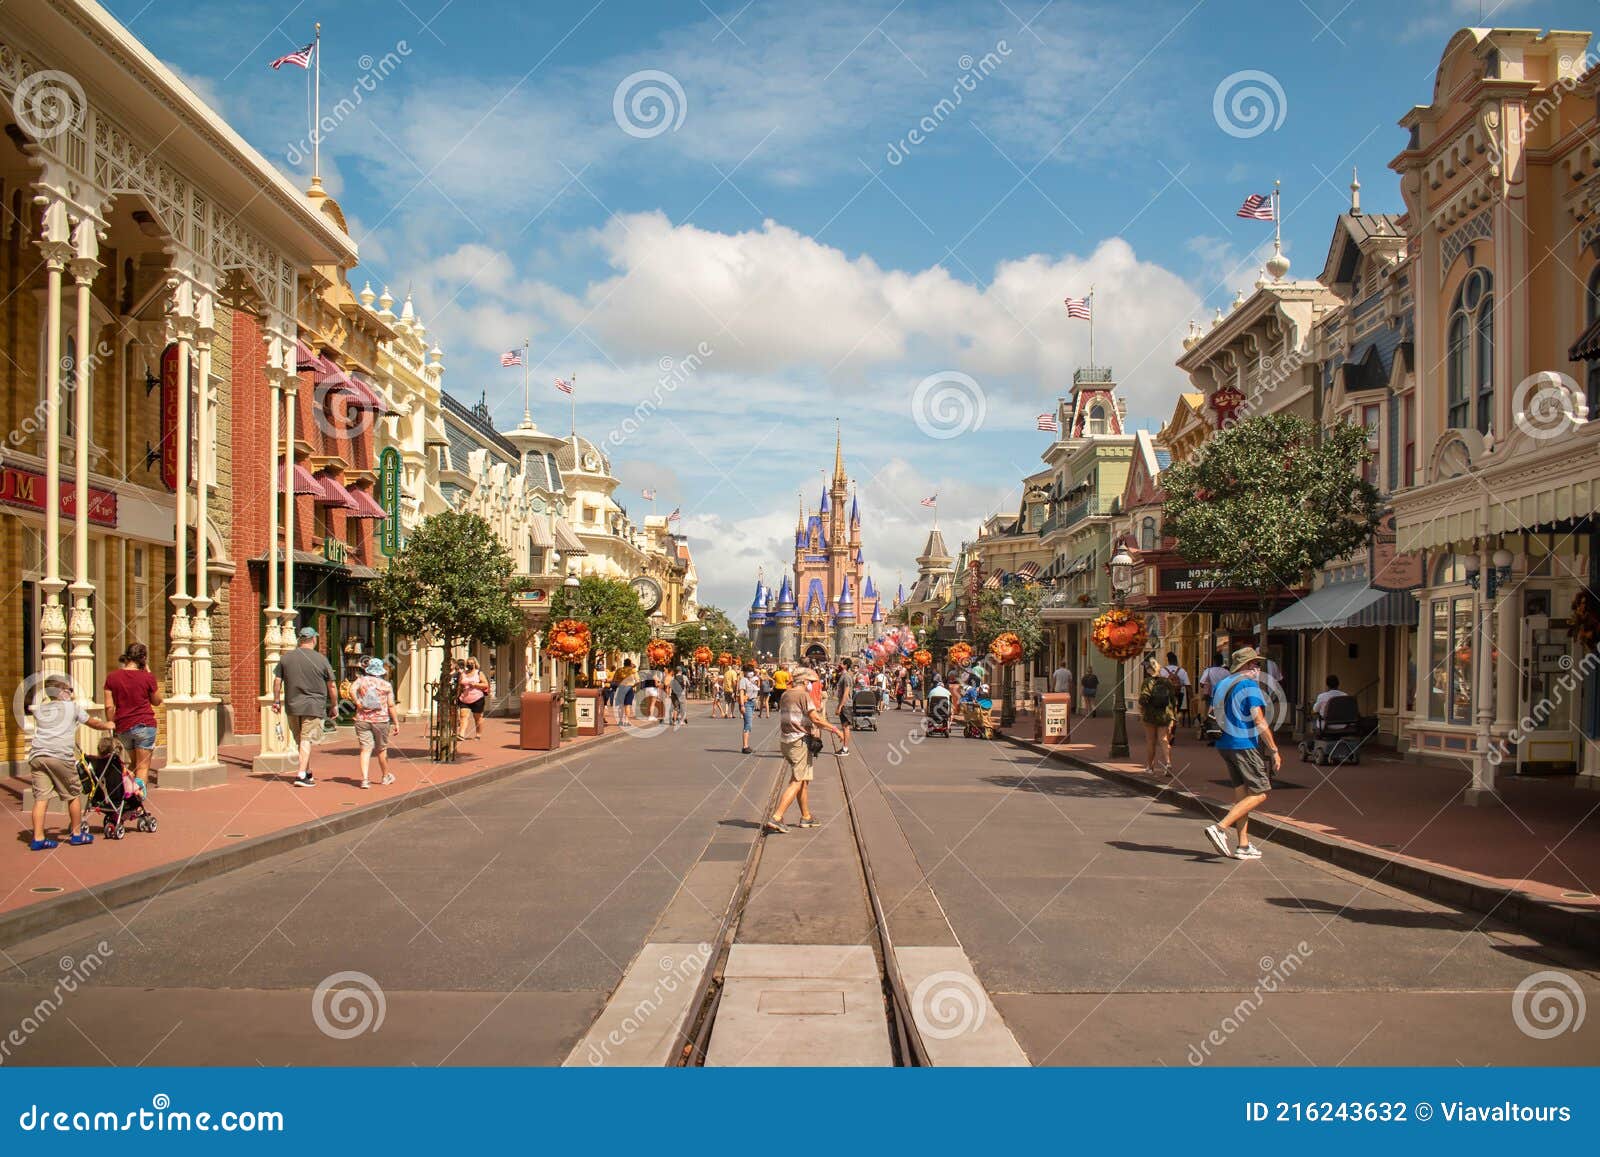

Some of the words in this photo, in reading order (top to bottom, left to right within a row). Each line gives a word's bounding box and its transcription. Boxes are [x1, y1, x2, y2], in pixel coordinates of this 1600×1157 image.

[386, 456, 394, 547] ARCADE
[1175, 581, 1192, 590] THE
[1198, 580, 1215, 589] ART
